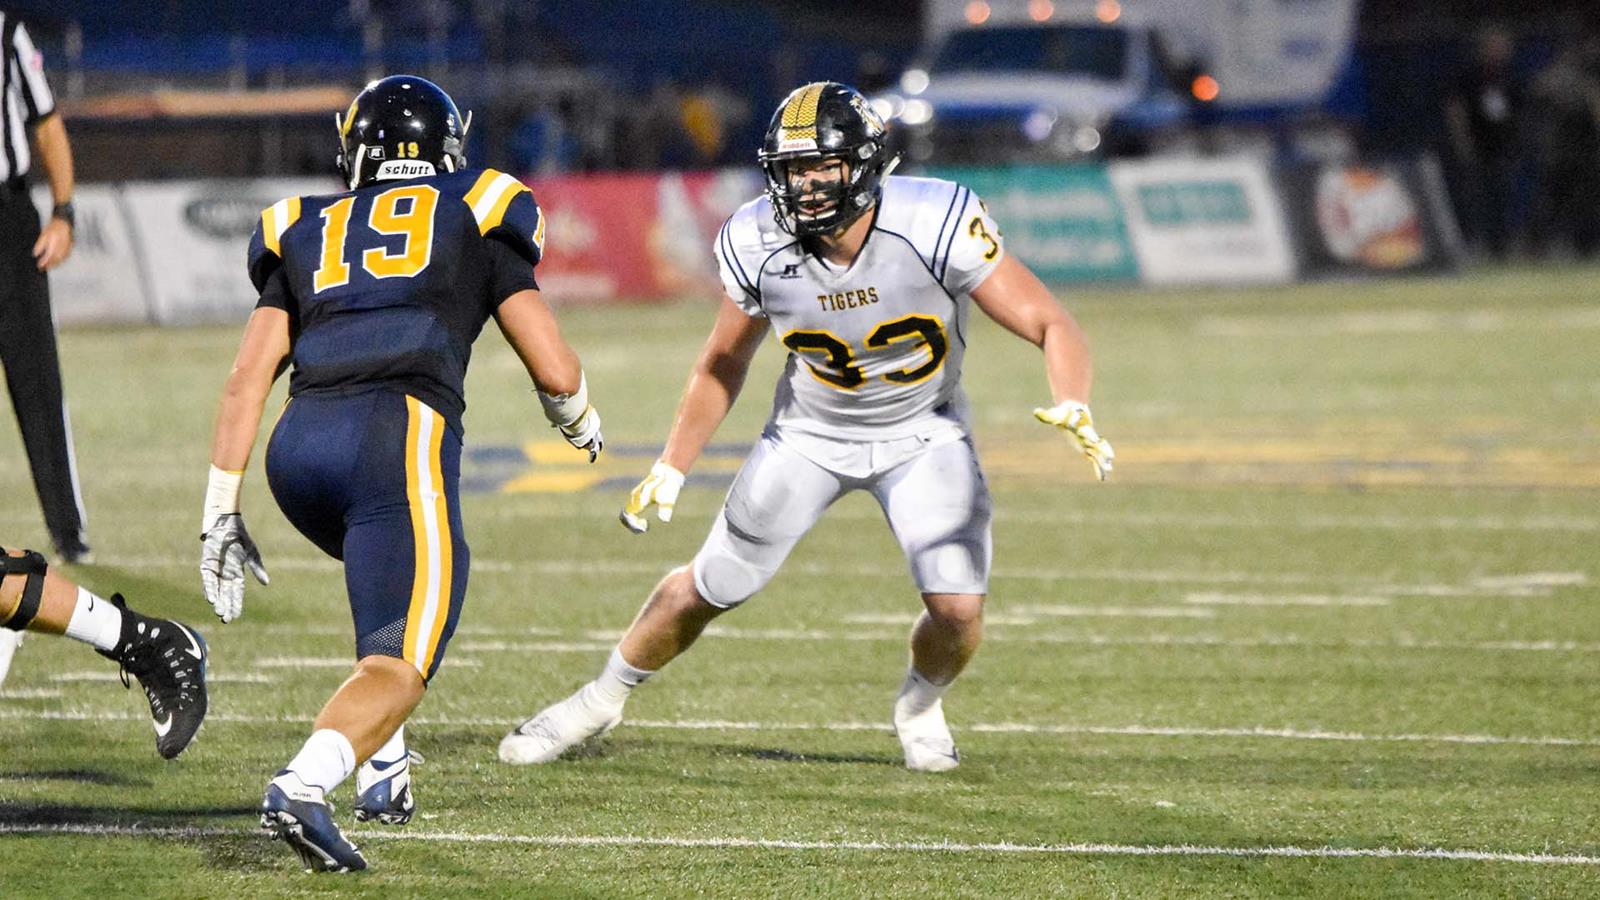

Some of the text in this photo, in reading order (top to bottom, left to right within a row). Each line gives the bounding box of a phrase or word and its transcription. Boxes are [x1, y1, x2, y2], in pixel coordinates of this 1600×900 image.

[385, 163, 430, 176] schutt
[398, 141, 419, 158] 19
[313, 184, 440, 294] 19
[968, 199, 1004, 261] 3
[817, 287, 879, 311] TIGERS
[782, 313, 947, 390] 33
